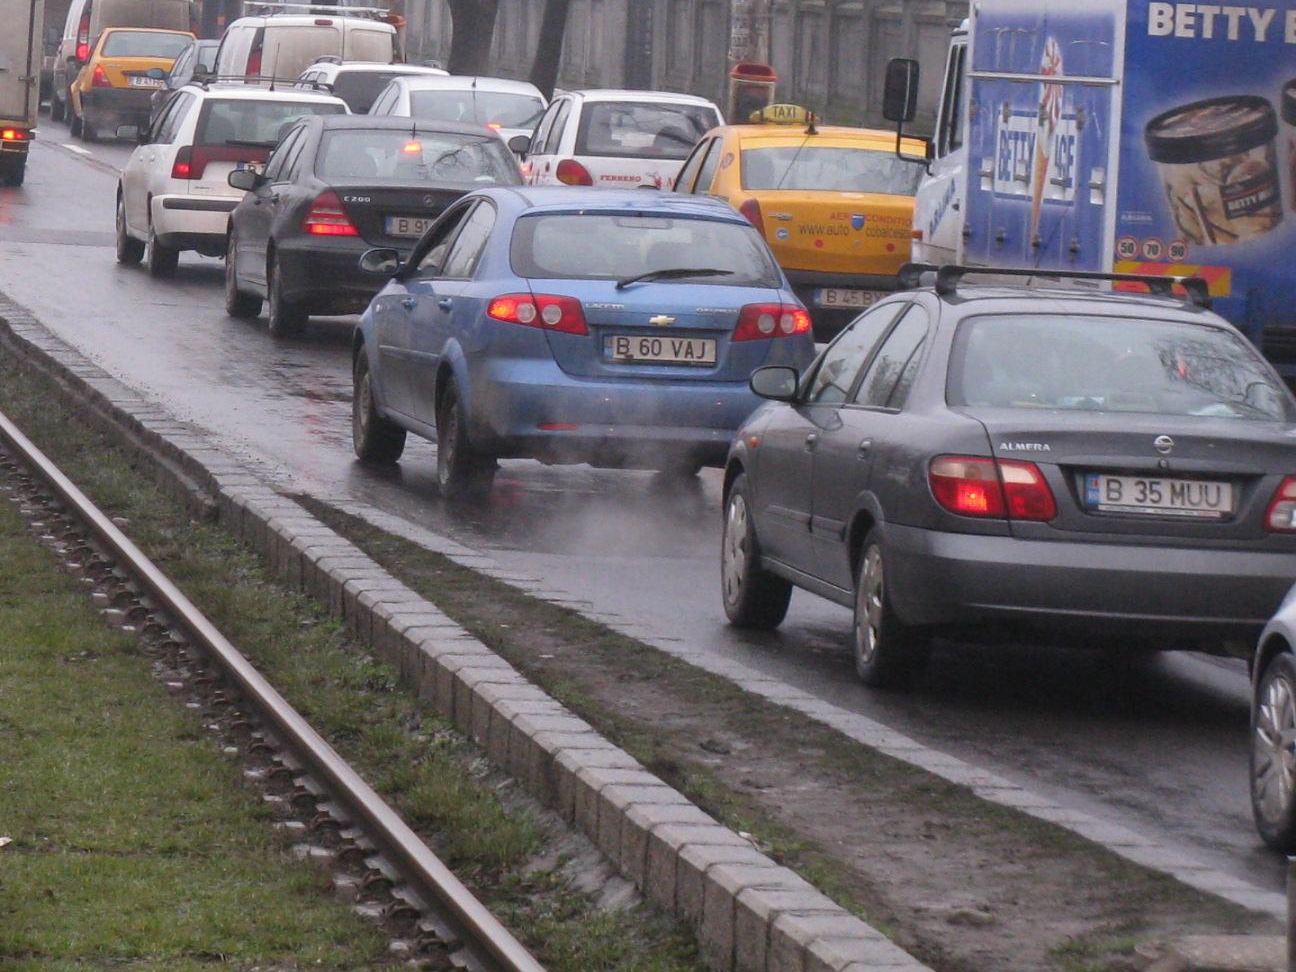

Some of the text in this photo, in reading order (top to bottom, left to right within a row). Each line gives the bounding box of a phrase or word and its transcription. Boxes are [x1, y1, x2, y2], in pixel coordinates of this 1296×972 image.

[1147, 2, 1276, 42] BETTY
[773, 105, 797, 118] TAXI
[998, 130, 1036, 188] BETTY
[600, 174, 642, 183] FERRERO
[1227, 194, 1258, 210] BETTY
[398, 219, 408, 233] B
[1120, 242, 1134, 254] 50
[1147, 244, 1159, 255] 70
[1171, 245, 1184, 257] 90
[826, 289, 837, 303] B
[616, 337, 706, 359] B 60 VAJ
[999, 441, 1051, 452] ALMERA
[1106, 480, 1222, 508] B 35 MUU
